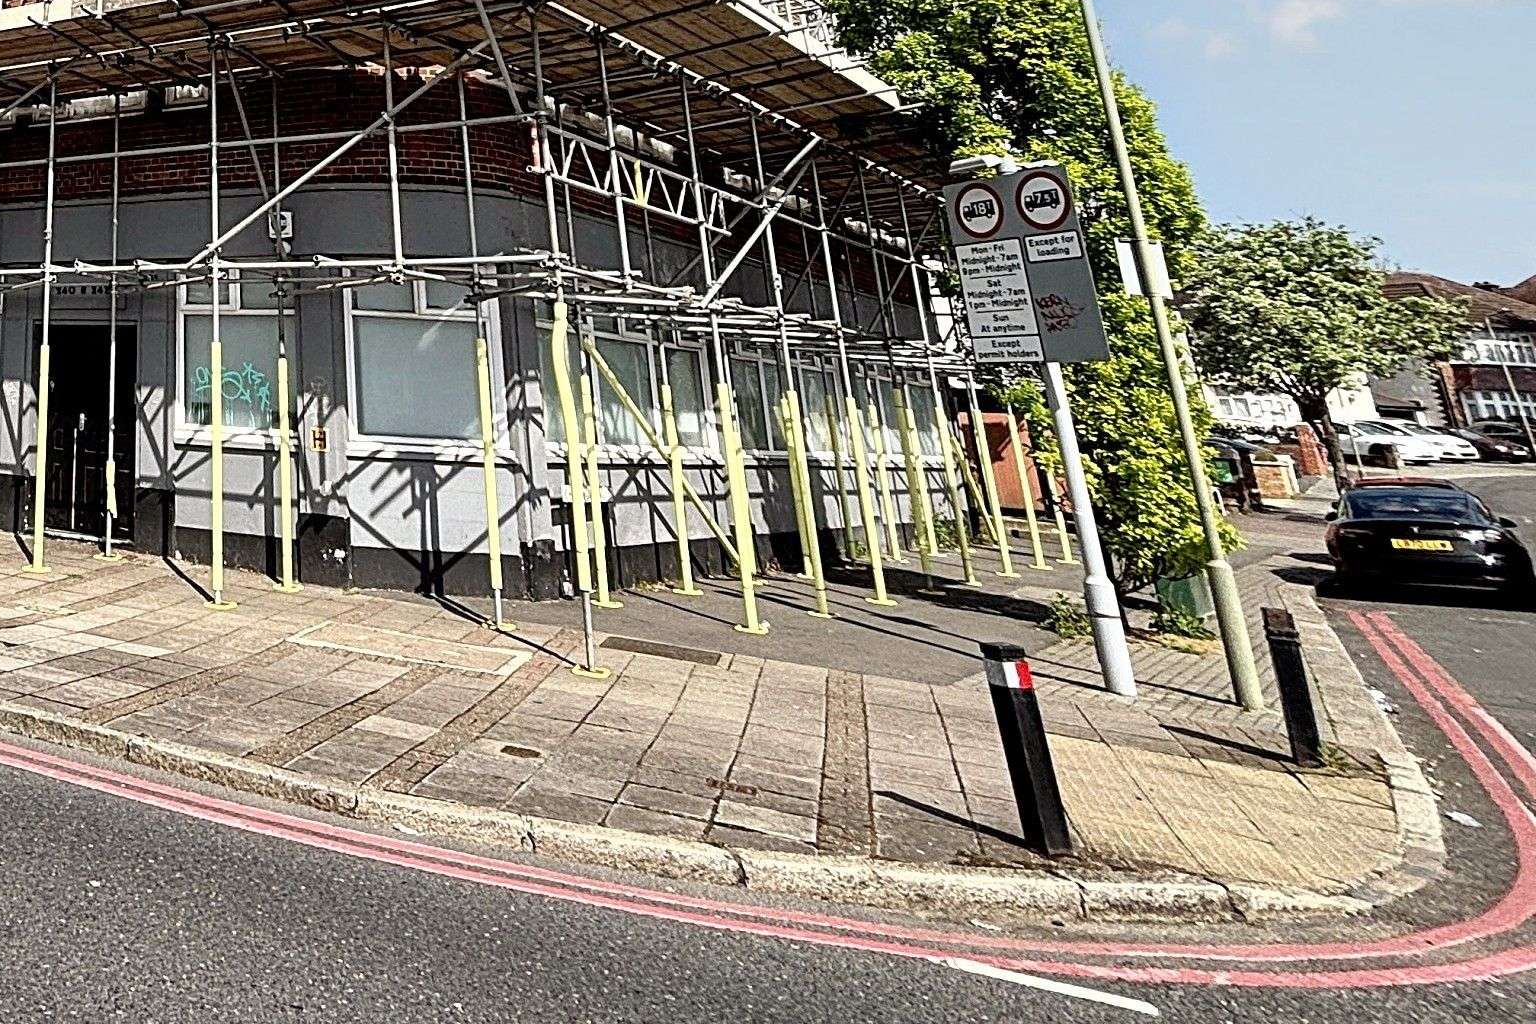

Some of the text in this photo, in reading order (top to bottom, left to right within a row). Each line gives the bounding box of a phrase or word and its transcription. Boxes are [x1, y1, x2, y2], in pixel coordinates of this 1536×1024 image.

[1028, 234, 1074, 247] Except for
[1037, 245, 1070, 256] loading
[987, 279, 1002, 287] Sat
[993, 314, 1009, 322] Sun
[981, 323, 1026, 333] At anytime
[991, 339, 1021, 349] Except
[978, 349, 1039, 359] permit holders
